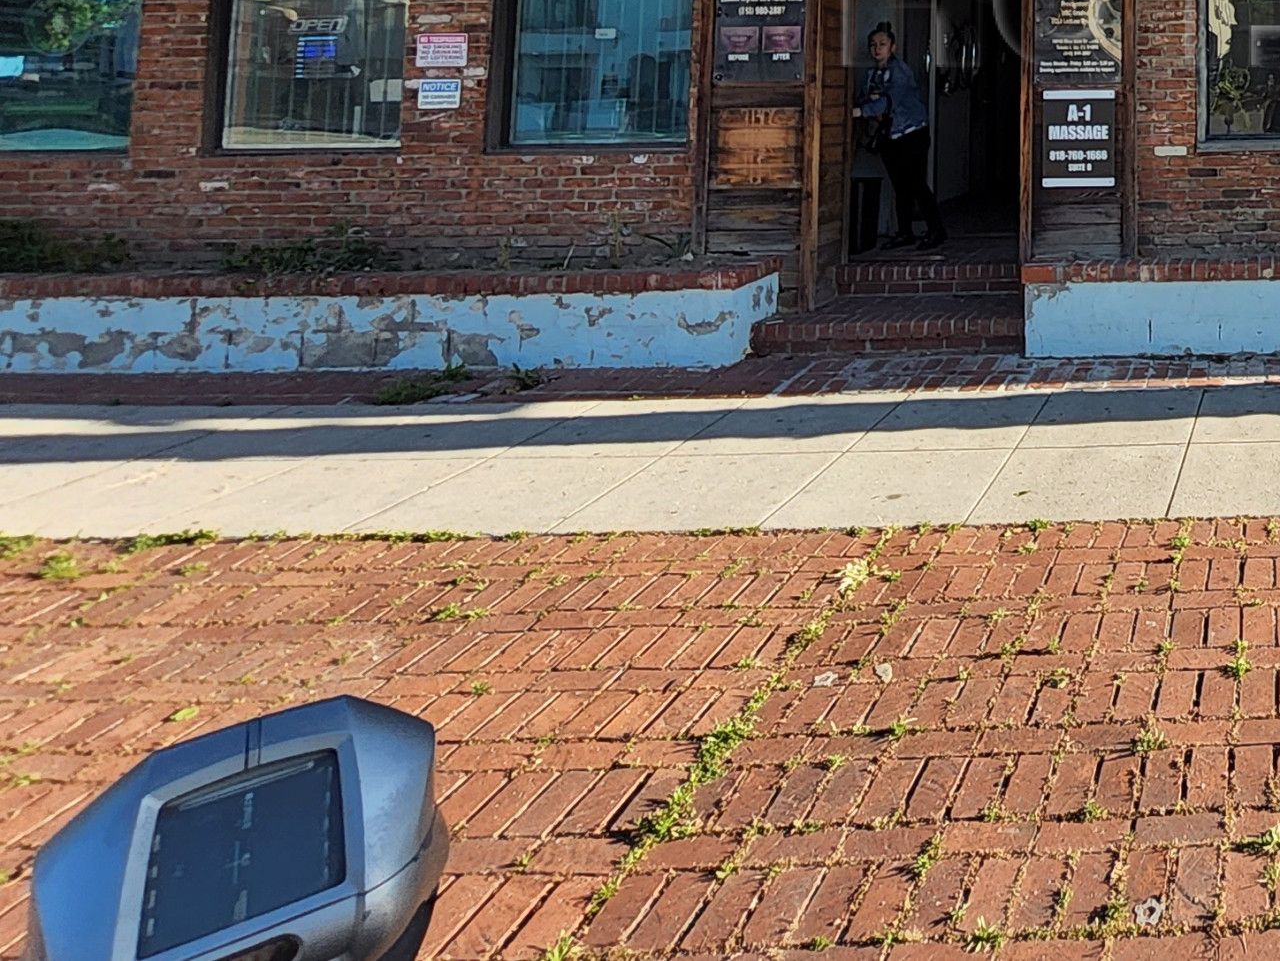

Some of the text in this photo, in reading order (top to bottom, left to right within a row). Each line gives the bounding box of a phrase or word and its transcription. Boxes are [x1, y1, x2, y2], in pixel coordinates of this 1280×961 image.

[290, 18, 343, 33] OPEN
[423, 82, 457, 91] NOTICE
[1067, 104, 1092, 122] A-1
[1048, 125, 1109, 140] MASSAGE
